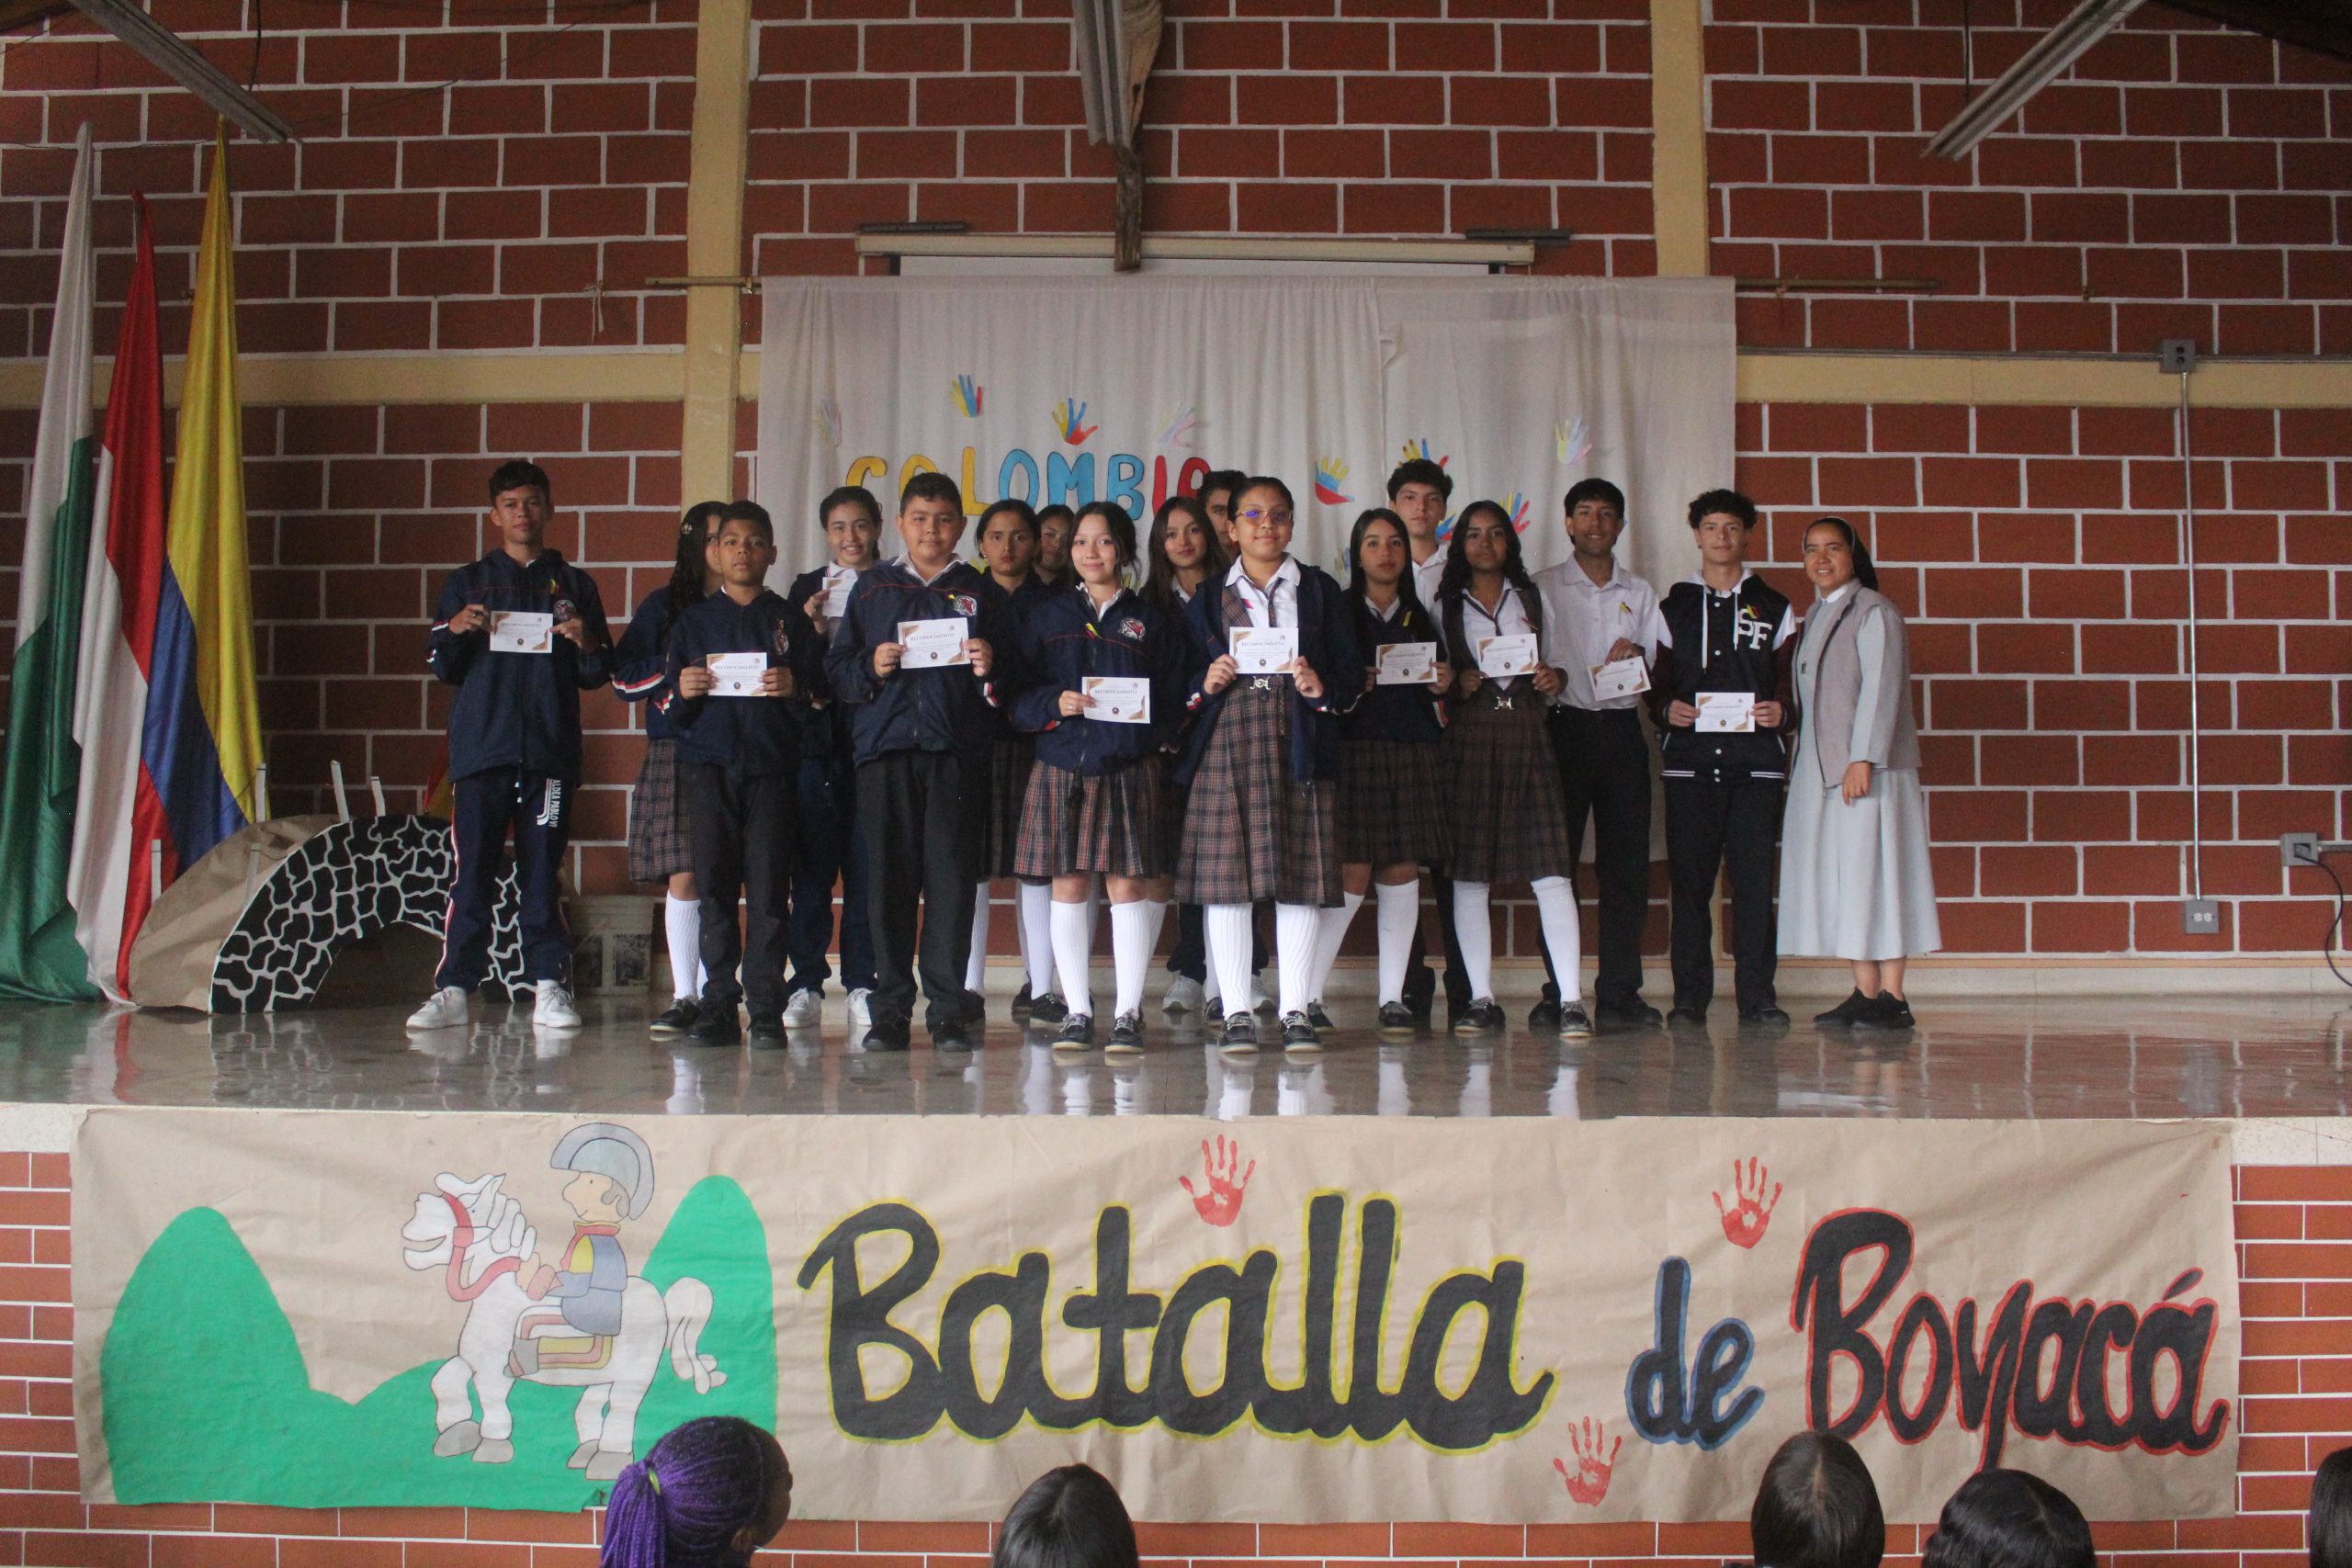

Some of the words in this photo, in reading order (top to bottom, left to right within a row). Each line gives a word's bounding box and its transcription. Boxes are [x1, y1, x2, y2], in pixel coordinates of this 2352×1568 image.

[551, 779, 561, 799] ALDEA
[549, 800, 560, 820] PABLO
[796, 1189, 1556, 1455] Batalla
[1625, 1256, 1765, 1450] de
[1790, 1207, 2231, 1472] Boyacá
